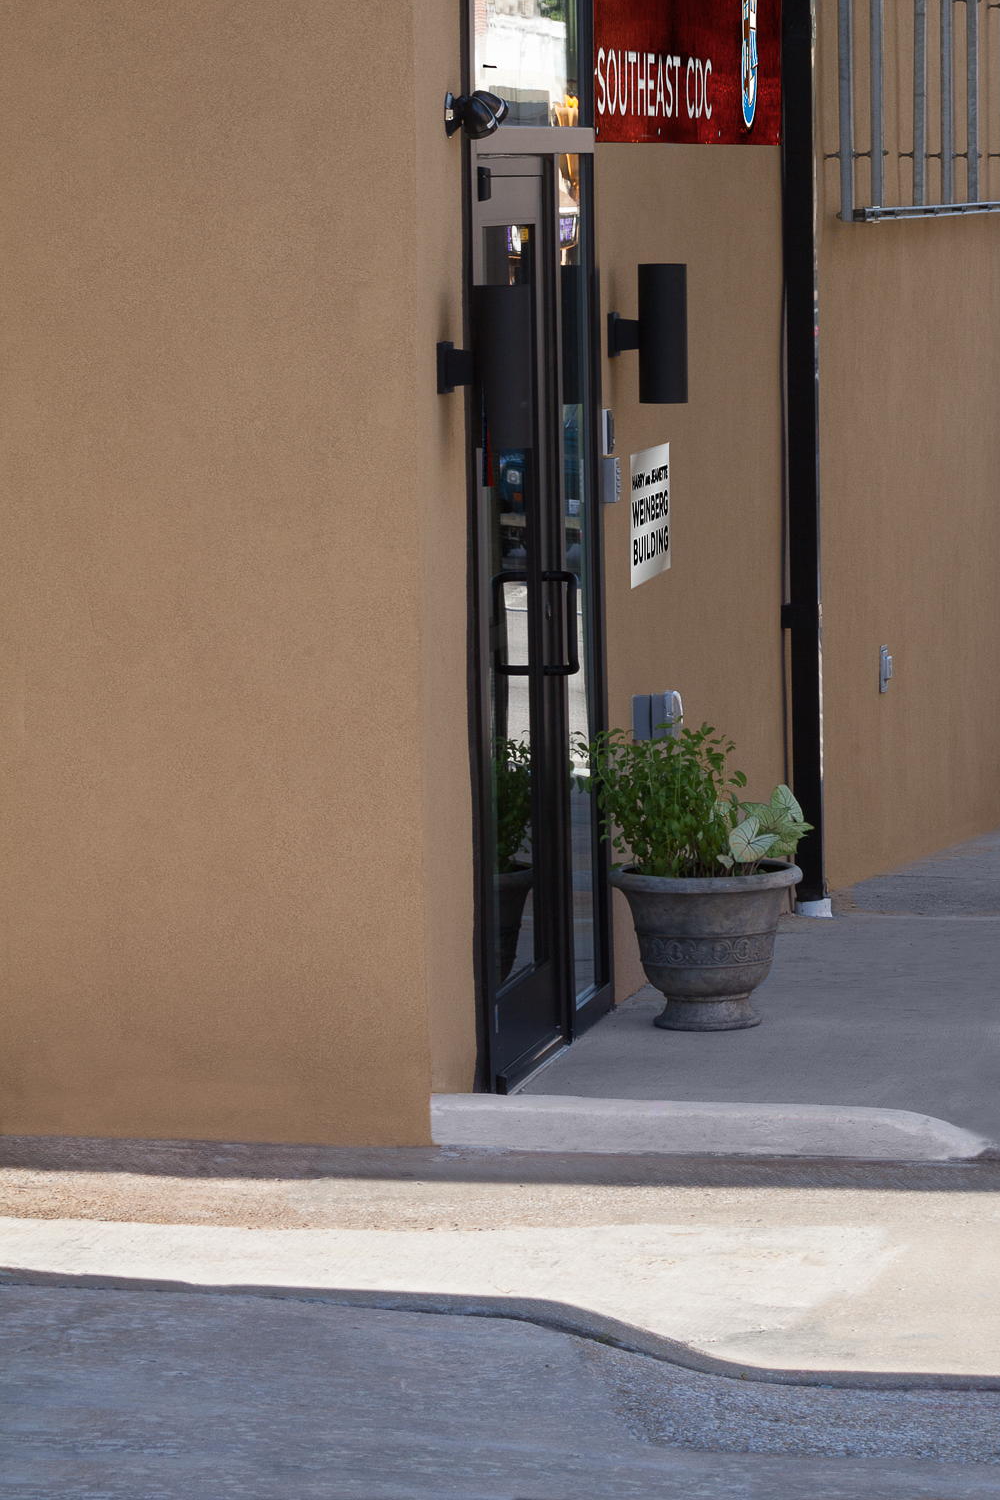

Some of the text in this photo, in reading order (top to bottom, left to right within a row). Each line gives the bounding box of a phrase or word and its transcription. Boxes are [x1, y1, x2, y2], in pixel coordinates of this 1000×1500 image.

[597, 47, 712, 120] SOUTHEAST CDC
[632, 489, 669, 529] WEINBERG
[633, 525, 669, 567] BUILDING
